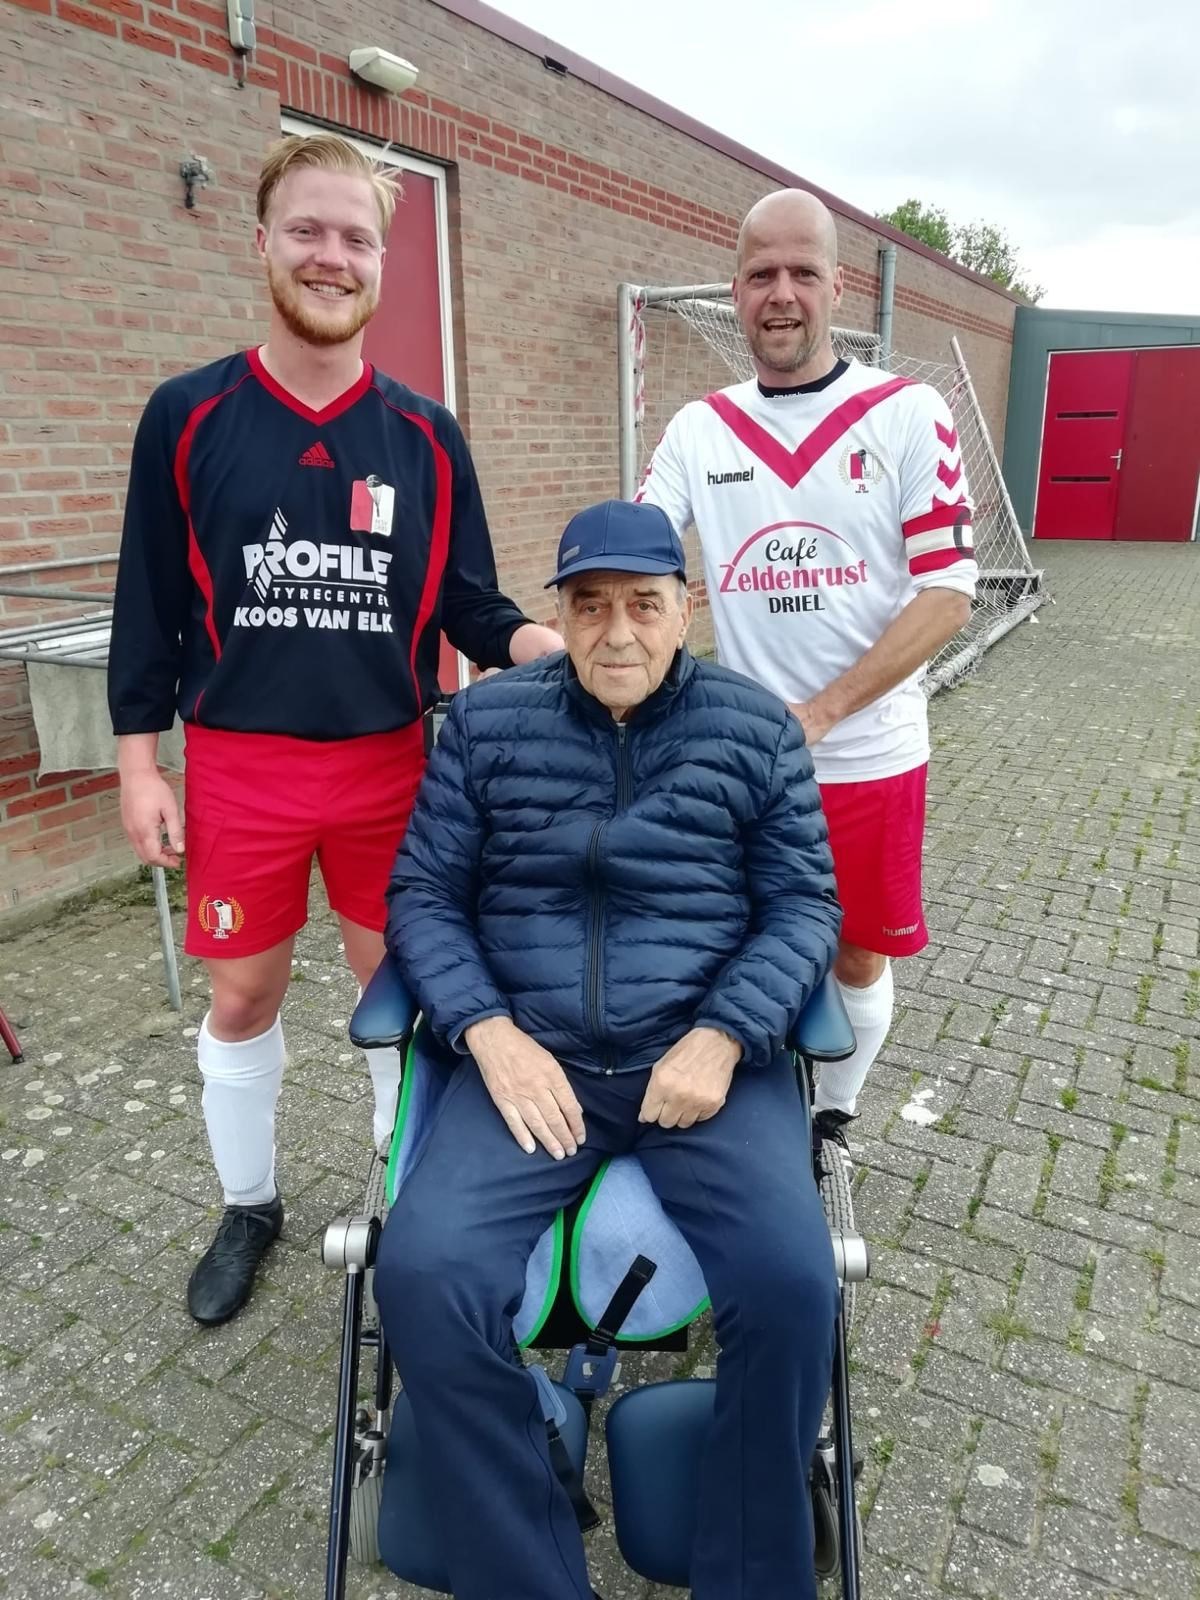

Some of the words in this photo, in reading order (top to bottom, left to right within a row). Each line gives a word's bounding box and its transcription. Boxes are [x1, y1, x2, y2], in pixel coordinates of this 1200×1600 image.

[298, 457, 336, 469] adidas
[707, 466, 754, 486] hummel
[242, 540, 393, 585] PROFILE
[765, 538, 818, 566] Café
[719, 559, 868, 594] Zeldenrust
[768, 594, 826, 614] DRIEL
[233, 606, 298, 628] KOOS
[303, 607, 351, 630] VAN
[357, 610, 394, 633] ELK
